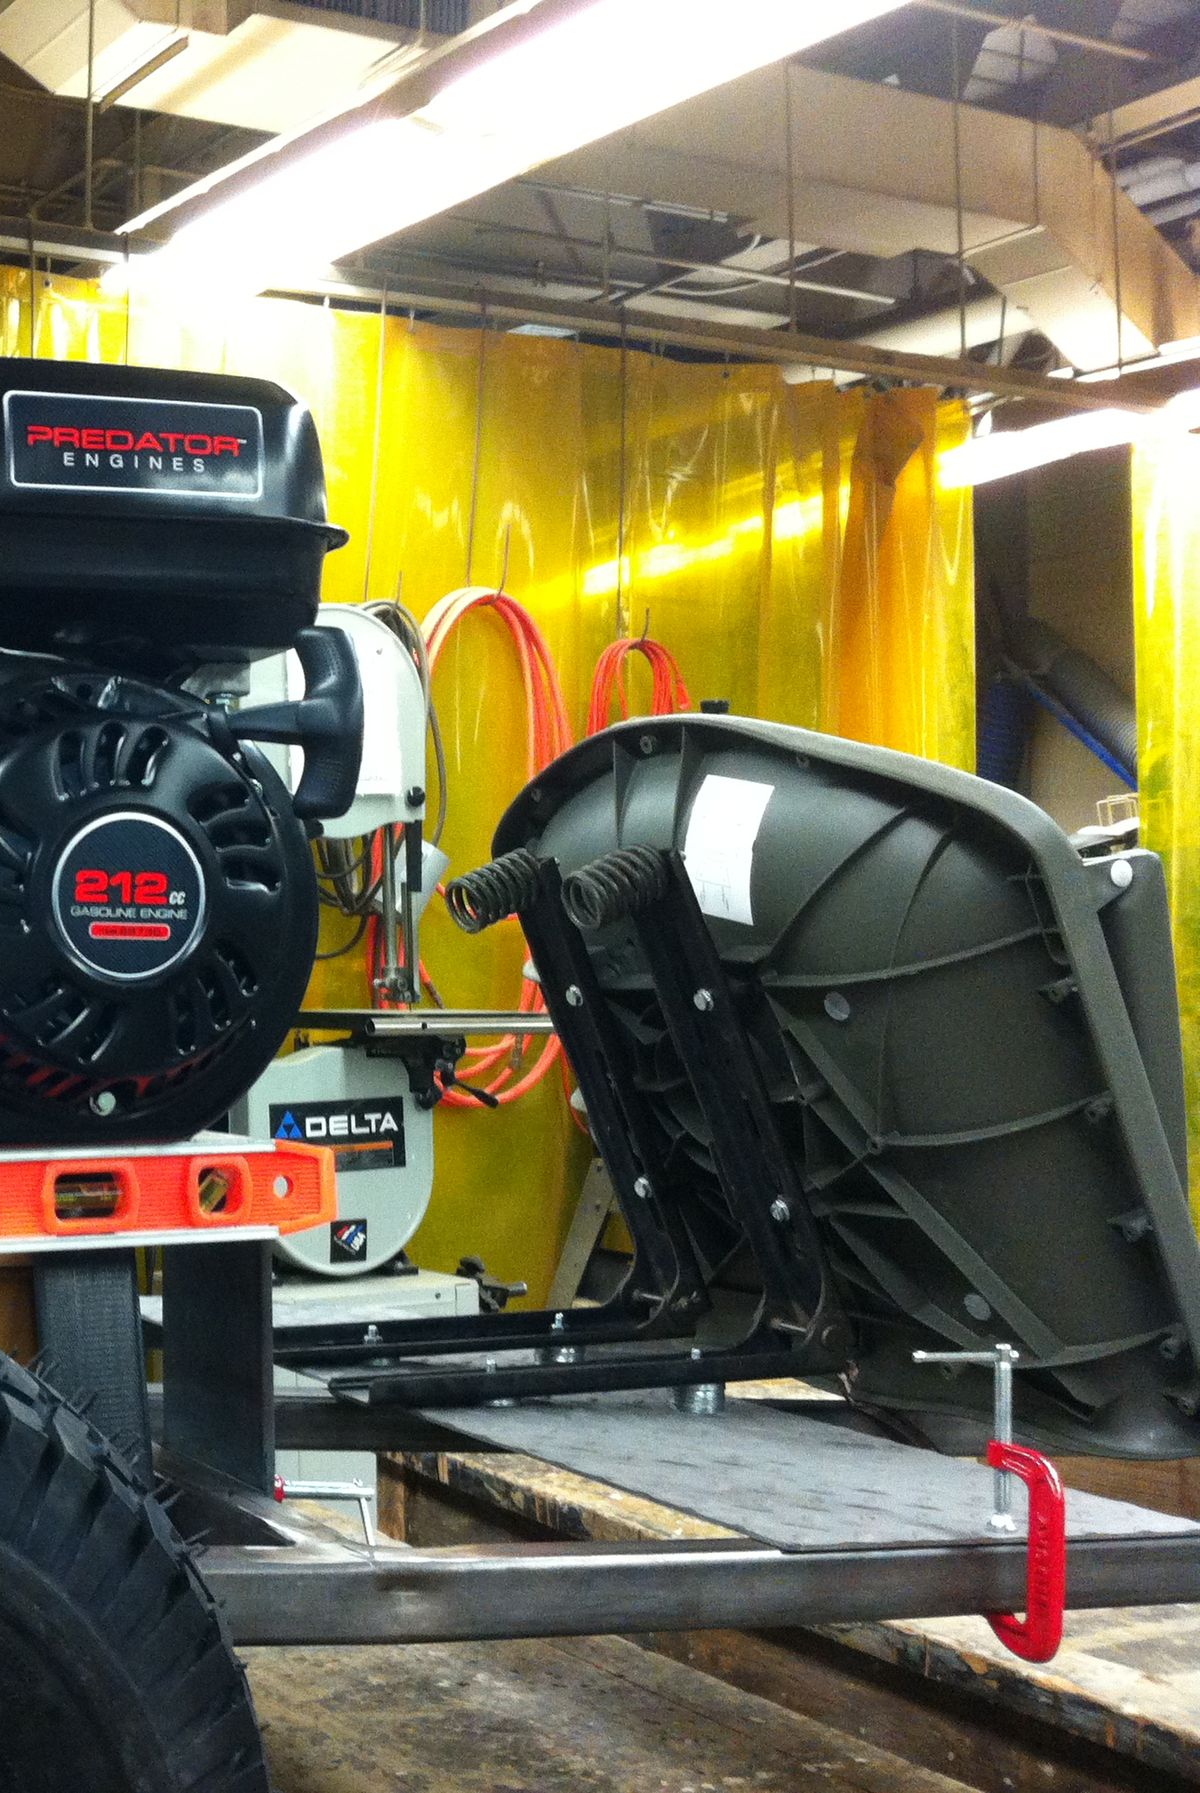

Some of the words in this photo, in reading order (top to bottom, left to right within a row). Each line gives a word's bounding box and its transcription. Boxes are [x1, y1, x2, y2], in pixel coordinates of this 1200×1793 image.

[27, 425, 241, 457] PREDATOR
[63, 452, 205, 473] ENGINES
[75, 869, 168, 905] 212
[70, 906, 136, 919] GASOLINE
[140, 909, 188, 920] ENGINE
[305, 1112, 399, 1138] DELTA
[350, 1231, 366, 1252] USA
